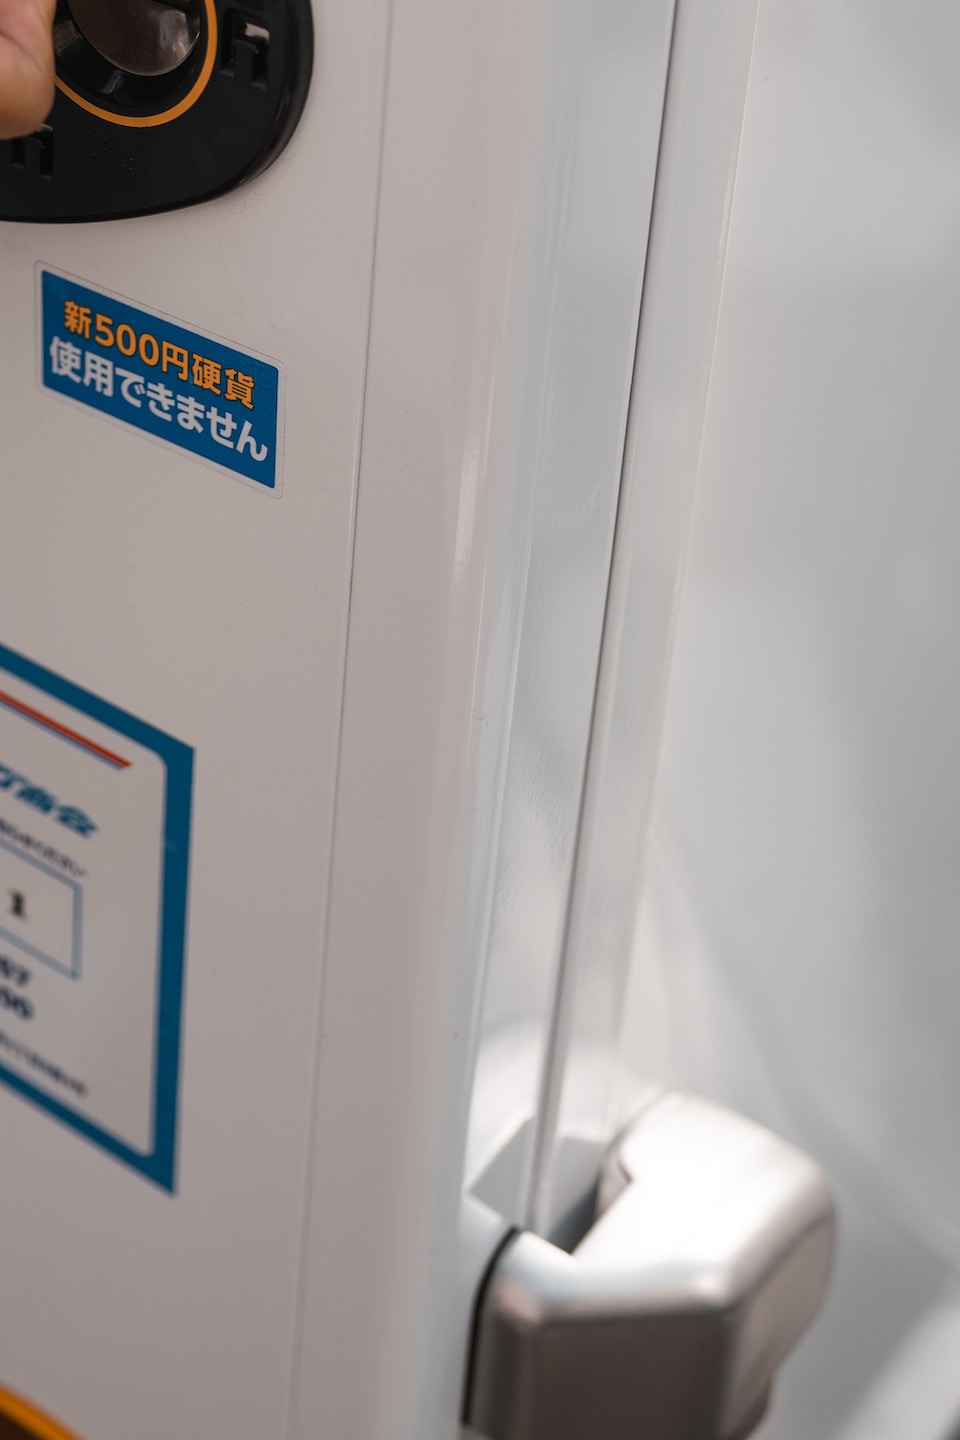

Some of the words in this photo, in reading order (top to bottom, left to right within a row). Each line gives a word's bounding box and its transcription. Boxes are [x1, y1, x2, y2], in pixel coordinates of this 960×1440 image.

[49, 335, 268, 462] 使用できません
[64, 300, 255, 409] 新500円硬貨
